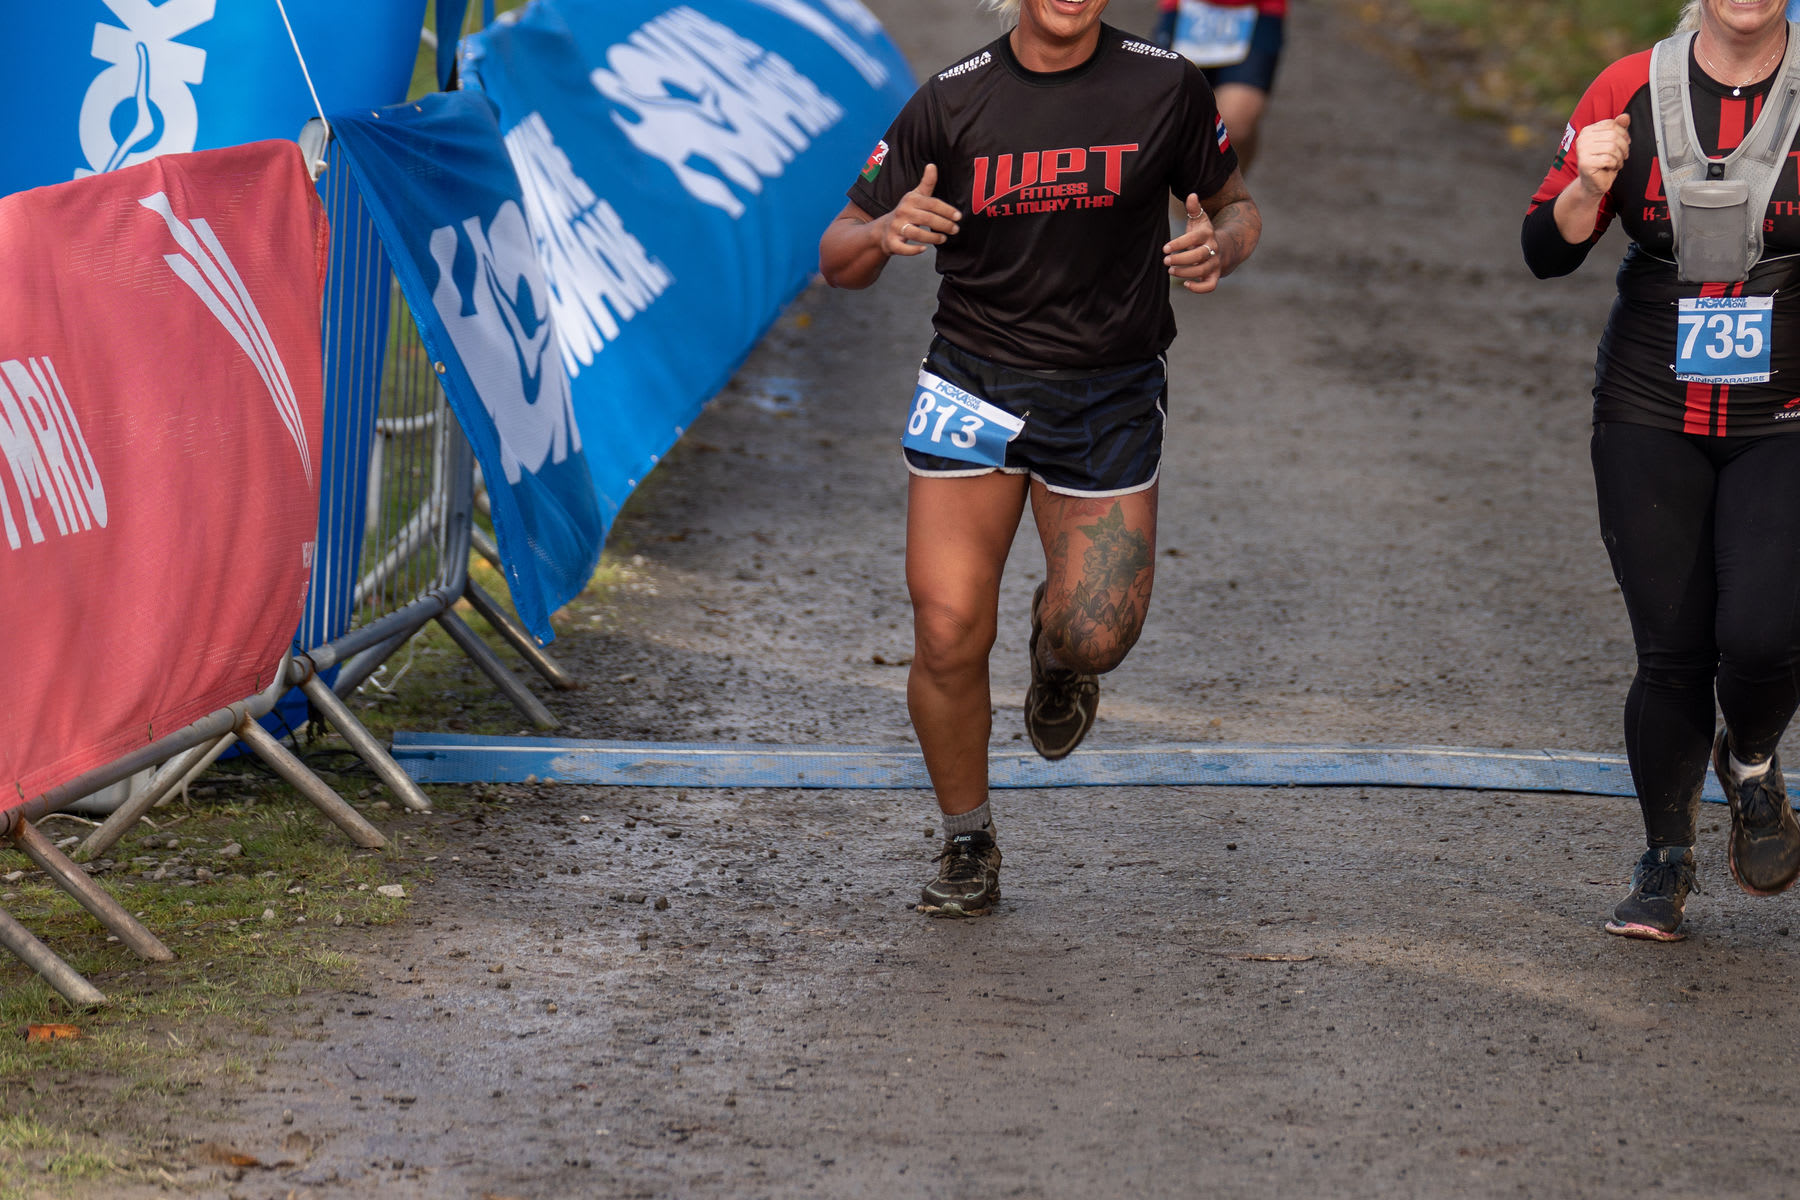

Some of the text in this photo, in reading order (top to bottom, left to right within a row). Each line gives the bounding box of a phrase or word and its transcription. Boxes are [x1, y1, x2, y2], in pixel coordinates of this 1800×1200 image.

[972, 143, 1139, 215] WPT
[1019, 182, 1089, 200] FITNESS
[1016, 196, 1071, 215] MUAY
[1694, 297, 1732, 309] HOKA
[1678, 313, 1763, 360] 735
[935, 380, 970, 405] HOKA
[908, 391, 985, 449] 813
